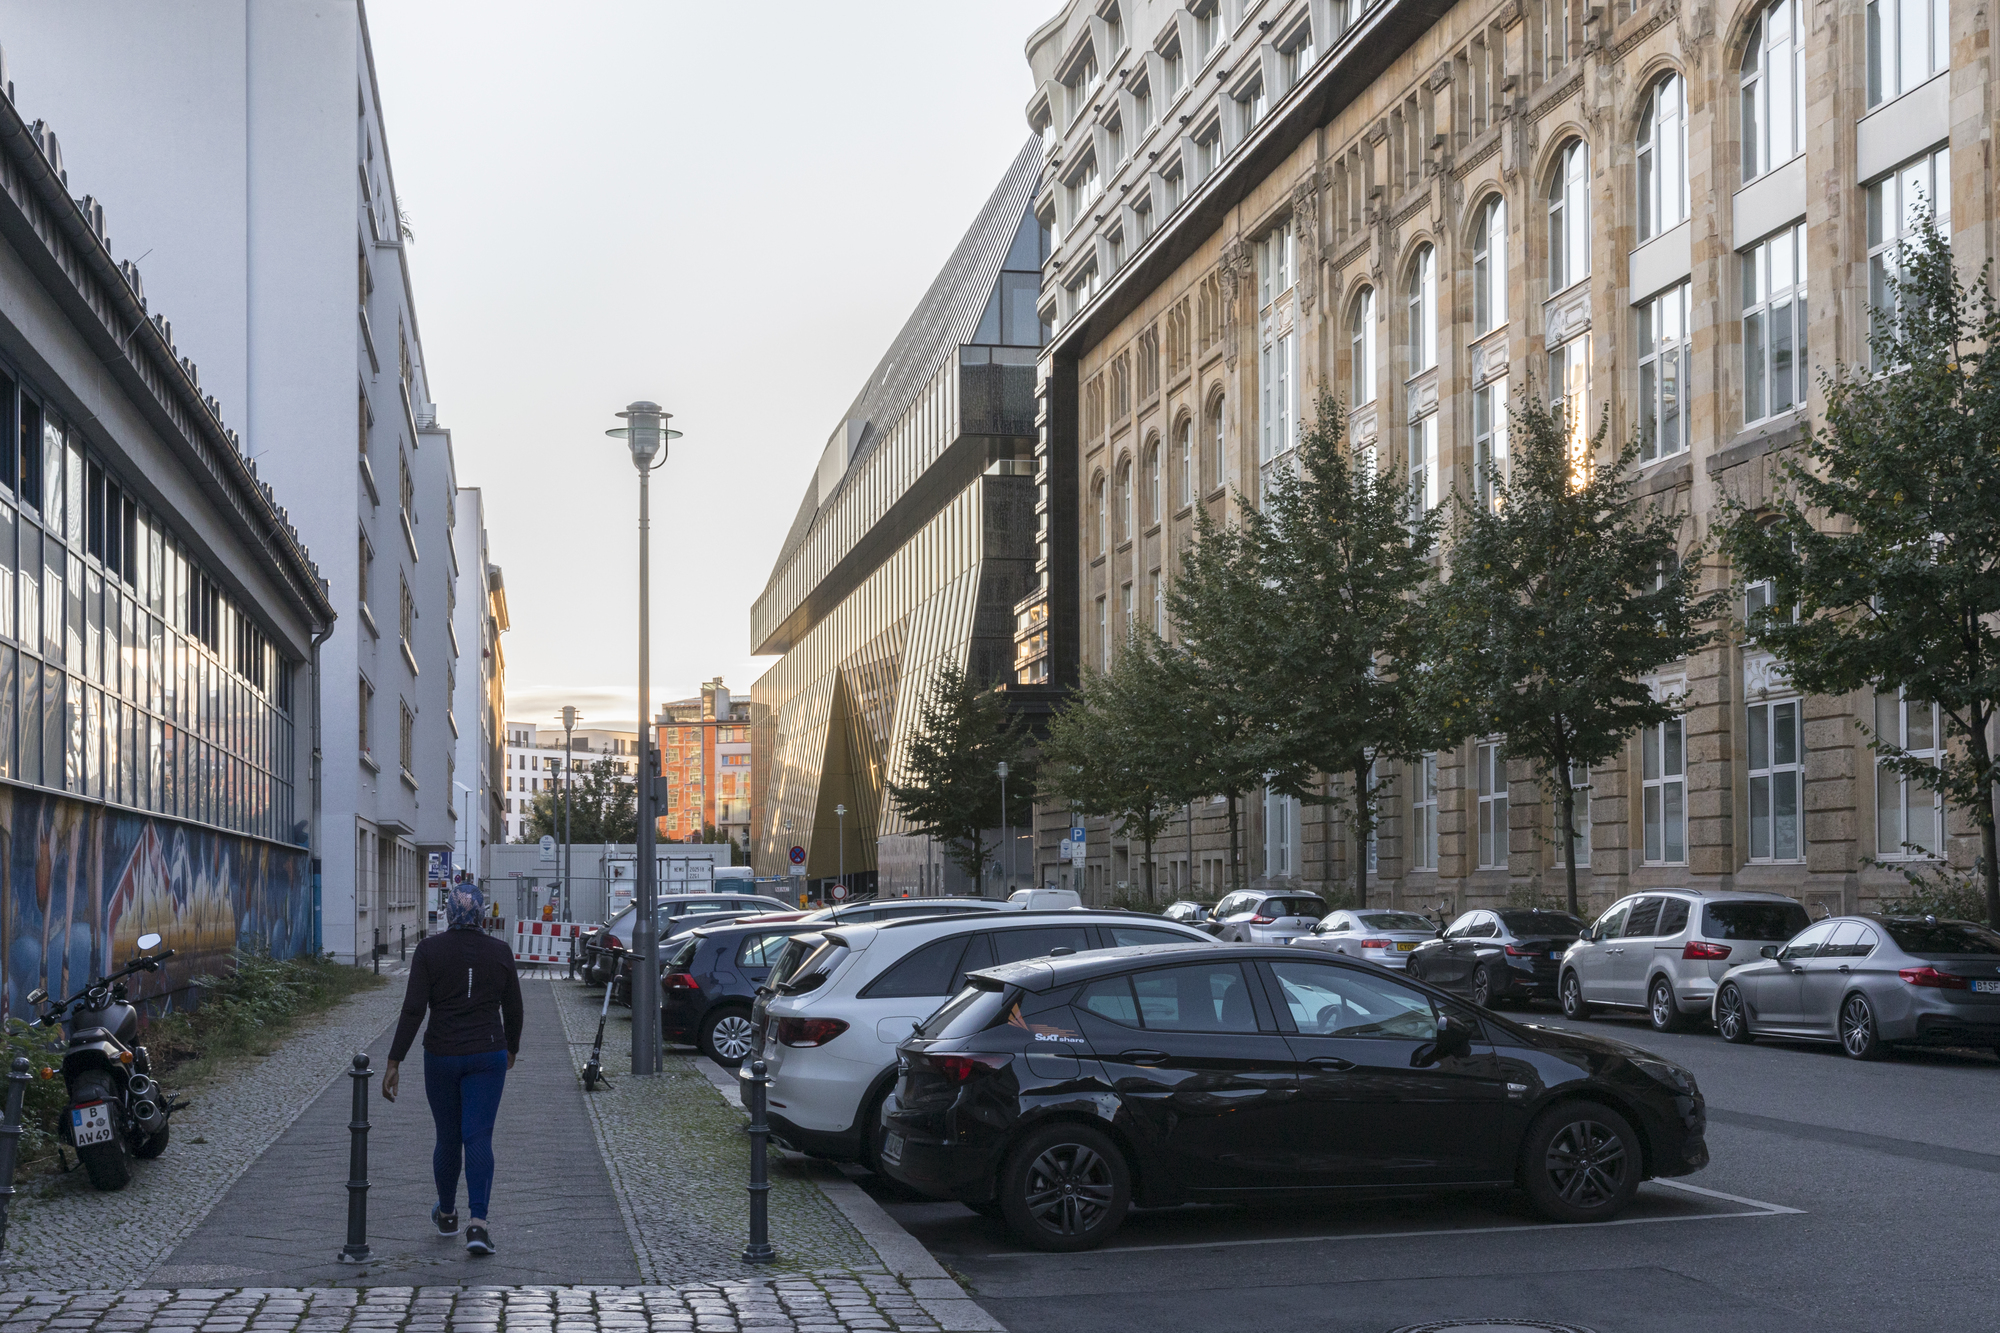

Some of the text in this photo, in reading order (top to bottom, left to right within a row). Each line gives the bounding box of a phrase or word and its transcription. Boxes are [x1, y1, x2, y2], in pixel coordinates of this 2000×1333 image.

[1074, 829, 1082, 841] P
[1059, 1036, 1085, 1044] share
[90, 1107, 98, 1118] B
[79, 1129, 110, 1145] AW 49
